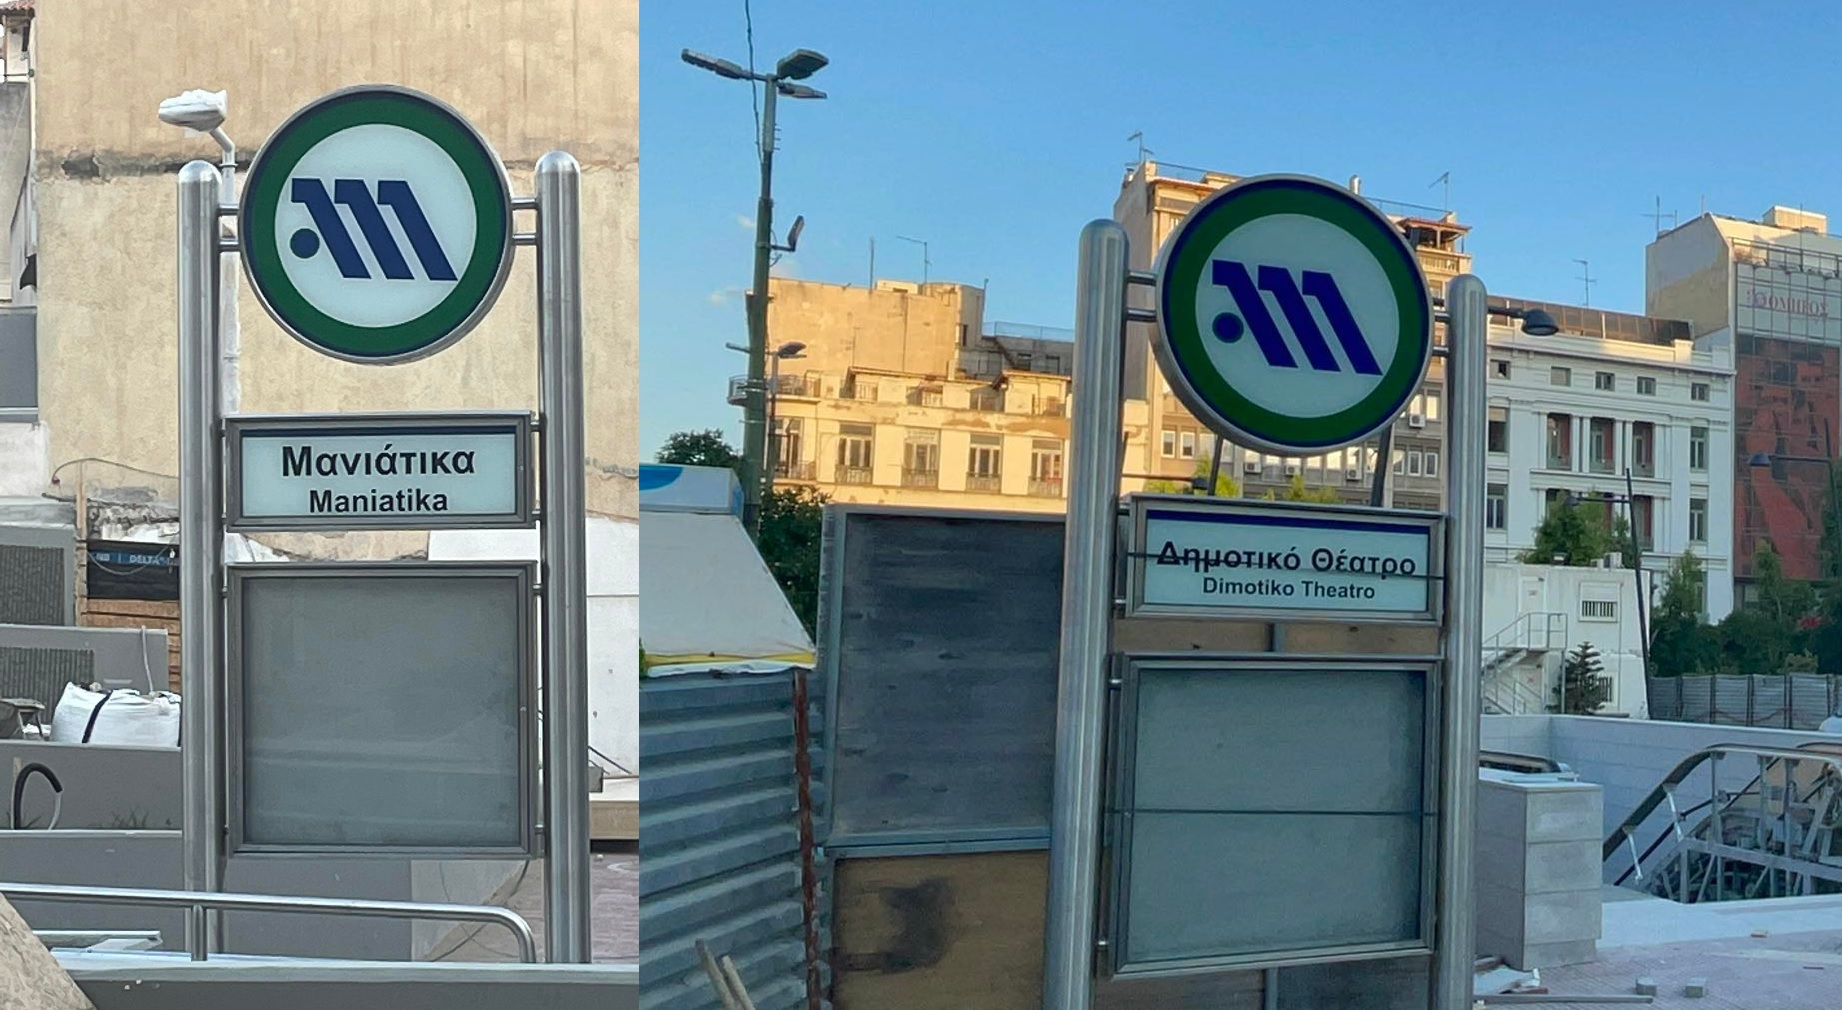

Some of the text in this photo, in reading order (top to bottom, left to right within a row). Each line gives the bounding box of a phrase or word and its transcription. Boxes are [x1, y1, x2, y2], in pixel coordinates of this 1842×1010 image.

[282, 444, 475, 476] Μανιάτικα
[309, 489, 449, 513] Maniatika
[1157, 541, 1416, 579] Δημοτικό Θέατρο
[1203, 577, 1376, 599] Dimotiko Theatro
